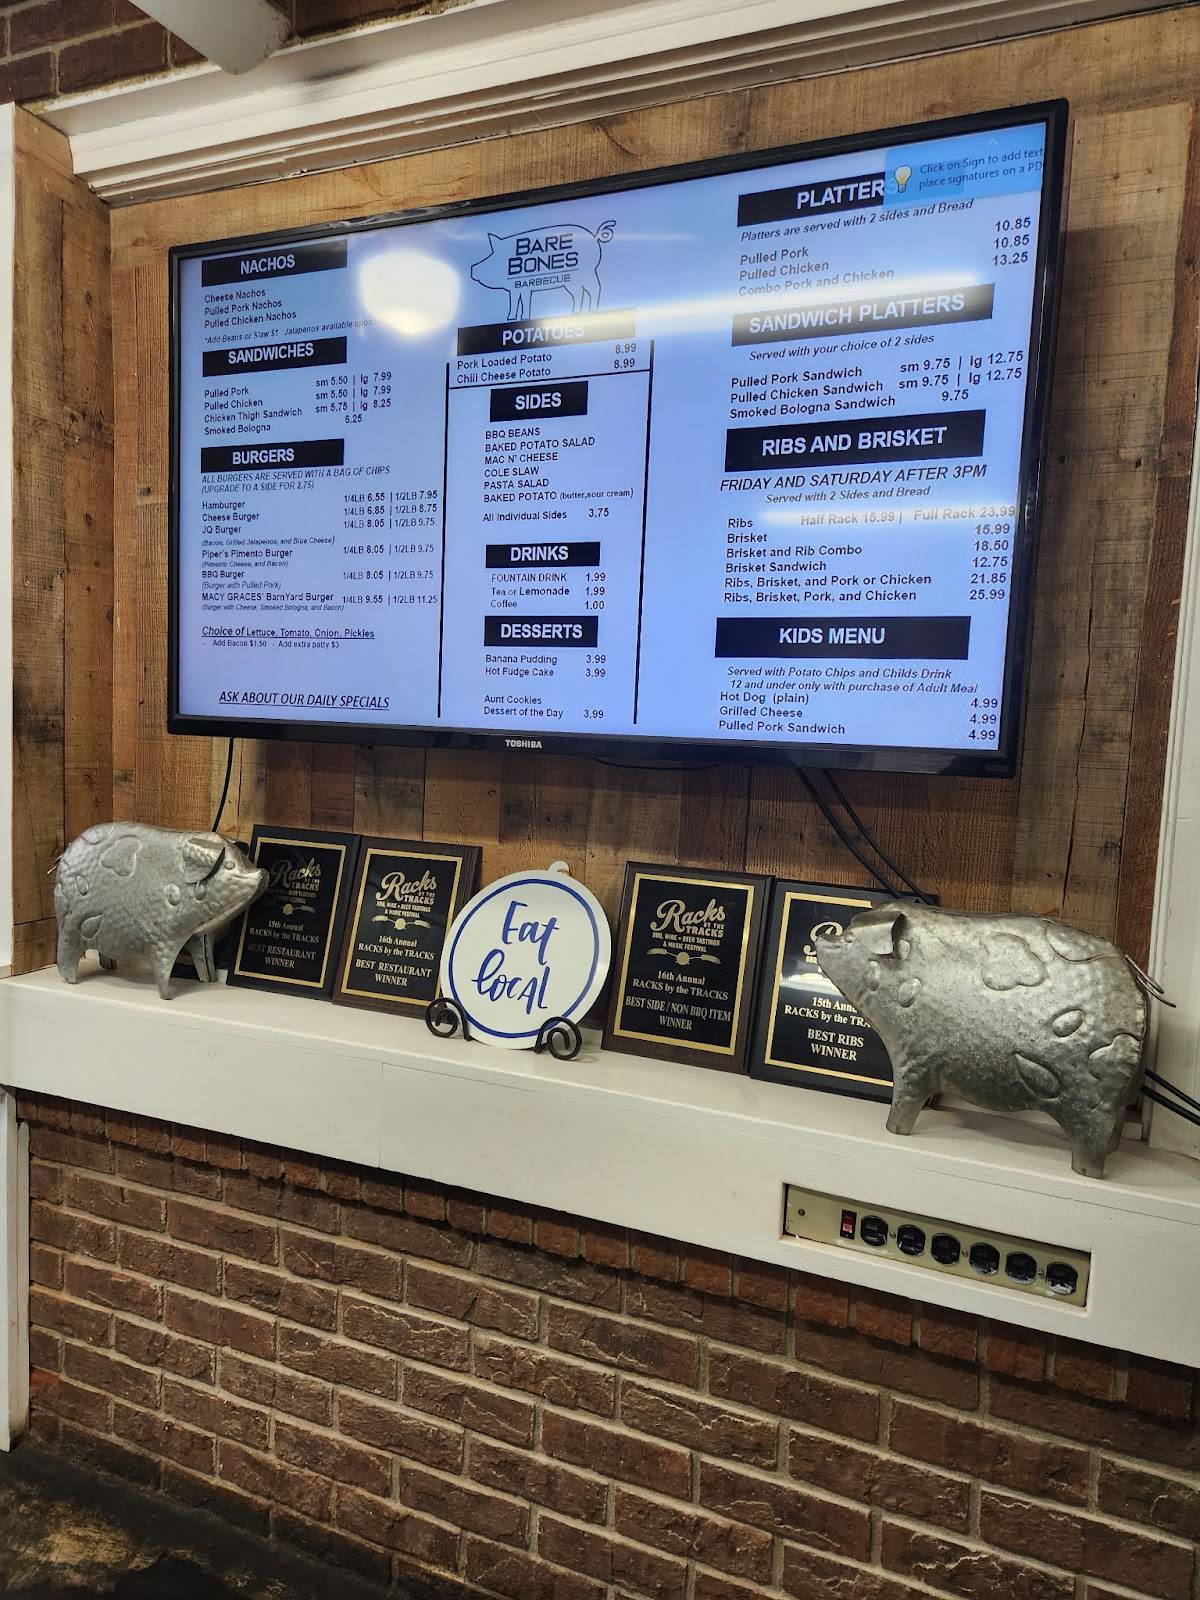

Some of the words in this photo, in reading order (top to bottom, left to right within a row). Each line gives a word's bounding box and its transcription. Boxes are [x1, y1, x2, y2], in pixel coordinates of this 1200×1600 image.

[920, 162, 944, 174] Click
[947, 161, 962, 170] on
[962, 157, 985, 170] Sign
[988, 155, 999, 164] to
[1000, 149, 1021, 162] add
[740, 229, 780, 242] Platters
[783, 226, 800, 236] are
[802, 218, 841, 233] served
[843, 214, 866, 227] with
[878, 208, 909, 222] sides
[912, 203, 936, 217] and
[937, 197, 974, 213] Bread
[995, 216, 1031, 232] 10.85
[515, 233, 572, 256] BARE
[993, 233, 1030, 249] 10.85
[507, 251, 578, 276] BONES
[740, 250, 777, 266] Pulled
[780, 246, 808, 260] Pork
[240, 254, 295, 275] NACHOS
[739, 265, 777, 281] Pulled
[778, 261, 829, 276] Chicken
[514, 273, 570, 289] BARBECUE
[204, 293, 234, 304] Cheese
[235, 288, 266, 299] Nachos
[748, 305, 852, 334] SANDWICH
[858, 293, 966, 322] PLATTERS
[502, 326, 585, 346] POTATOES
[228, 342, 314, 364] SANDWICHES
[615, 342, 637, 354] 8.99
[457, 359, 479, 370] Pork
[481, 354, 517, 368] Loaded
[519, 353, 552, 364] Potato
[900, 363, 919, 373] sm
[923, 357, 950, 371] 9.75
[970, 355, 982, 369] lg
[987, 349, 1023, 365] 12.75
[315, 379, 328, 387] sm
[330, 375, 348, 386] 5.50
[360, 373, 368, 385] lg
[373, 371, 392, 381] 7.99
[731, 374, 767, 388] Pulled
[771, 372, 798, 385] Pork
[802, 366, 862, 382] Sandwich
[204, 387, 229, 398] Pulled
[230, 386, 249, 396] Pork
[941, 388, 969, 402] 9.75
[204, 400, 229, 411] Pulled
[230, 398, 263, 409] Chicken
[514, 392, 561, 410] SIDES
[729, 404, 777, 419] Smoked
[780, 402, 830, 415] Bologna
[834, 394, 895, 410] Sandwich
[344, 413, 362, 424] 6.25
[204, 424, 236, 435] Smoked
[237, 423, 271, 434] Bologna
[484, 441, 517, 453] BAKED
[519, 439, 559, 450] POTATO
[562, 436, 595, 448] SALAD
[762, 437, 806, 456] RIBS
[809, 433, 851, 453] AND
[857, 426, 947, 449] BRISKET
[232, 447, 294, 465] BURGERS
[719, 476, 772, 491] FRIDAY
[773, 475, 805, 488] AND
[809, 469, 893, 487] SATURDAY
[894, 466, 948, 482] AFTER
[952, 464, 987, 479] 3PM
[202, 500, 245, 511] Hamburger
[588, 507, 609, 518] 3.75
[202, 513, 230, 522] Cheese
[232, 512, 260, 522] Burger
[482, 513, 494, 522] All
[496, 511, 540, 521] Individual
[542, 510, 567, 519] Sides
[974, 522, 1010, 535] 15.99
[727, 532, 767, 544] Brisket
[973, 539, 1009, 552] 18.50
[510, 545, 568, 561] DRINKS
[726, 547, 766, 558] Brisket
[769, 546, 791, 557] and
[795, 545, 815, 556] Rib
[818, 544, 862, 556] Combo
[202, 570, 218, 578] BBQ
[220, 570, 245, 580] Burger
[724, 577, 753, 588] Ribs,
[756, 576, 801, 587] Brisket,
[804, 575, 827, 586] and
[830, 574, 859, 586] Pork
[862, 577, 876, 585] or
[879, 573, 931, 585] Chicken
[970, 572, 1006, 584] 21.85
[500, 623, 583, 638] DESSERTS
[779, 627, 823, 644] KIDS
[828, 627, 885, 644] MENU
[485, 654, 518, 663] Banana
[520, 654, 557, 666] Pudding
[585, 654, 606, 664] 3.99
[218, 691, 241, 705] ASK
[240, 691, 279, 706] ABOUT
[280, 693, 305, 705] OUR
[306, 694, 338, 706] DAILY
[339, 695, 390, 708] SPECIALS
[720, 691, 740, 701] Hot
[743, 691, 766, 705] Dog
[772, 692, 809, 705] (plain)
[970, 698, 998, 709] 4.99
[483, 706, 517, 716] Dessert
[518, 707, 528, 716] of
[529, 707, 544, 717] the
[546, 708, 564, 720] Day
[583, 709, 604, 719] 3.99
[719, 705, 757, 717] Grilled
[760, 706, 802, 718] Cheese
[718, 719, 754, 731] Pulled
[757, 721, 783, 732] Pork
[787, 722, 845, 734] Sandwich
[969, 714, 997, 725] 4.99
[968, 730, 996, 741] 4.99
[505, 739, 542, 749] TOSHIBA
[375, 869, 437, 901] Racks
[403, 894, 434, 905] TRACKS
[650, 898, 726, 933] Racks
[501, 900, 560, 966] Eat
[685, 926, 724, 938] TRACKS
[378, 935, 393, 944] 16th
[392, 937, 417, 947] Annual
[264, 956, 295, 969] WINNER
[355, 958, 376, 969] BEST
[378, 961, 432, 978] RESTAURANT
[374, 973, 408, 986] WINNER
[657, 970, 674, 981] 16th
[675, 973, 705, 985] Annual
[632, 978, 663, 991] RACKS
[664, 982, 675, 994] by
[676, 984, 689, 994] the
[690, 986, 728, 1000] TRACKS
[625, 995, 646, 1008] BEST
[646, 998, 665, 1011] SIDE
[670, 1002, 689, 1014] NON
[689, 1005, 707, 1020] BBQ
[709, 1008, 731, 1022] ITEM
[812, 997, 832, 1009] 15th
[659, 1014, 692, 1030] WINNER
[784, 1005, 819, 1019] RACKS
[821, 1011, 833, 1023] by
[834, 1012, 848, 1025] the
[807, 1028, 836, 1043] BEST
[837, 1033, 864, 1048] RIBS
[810, 1043, 857, 1061] WINNER
